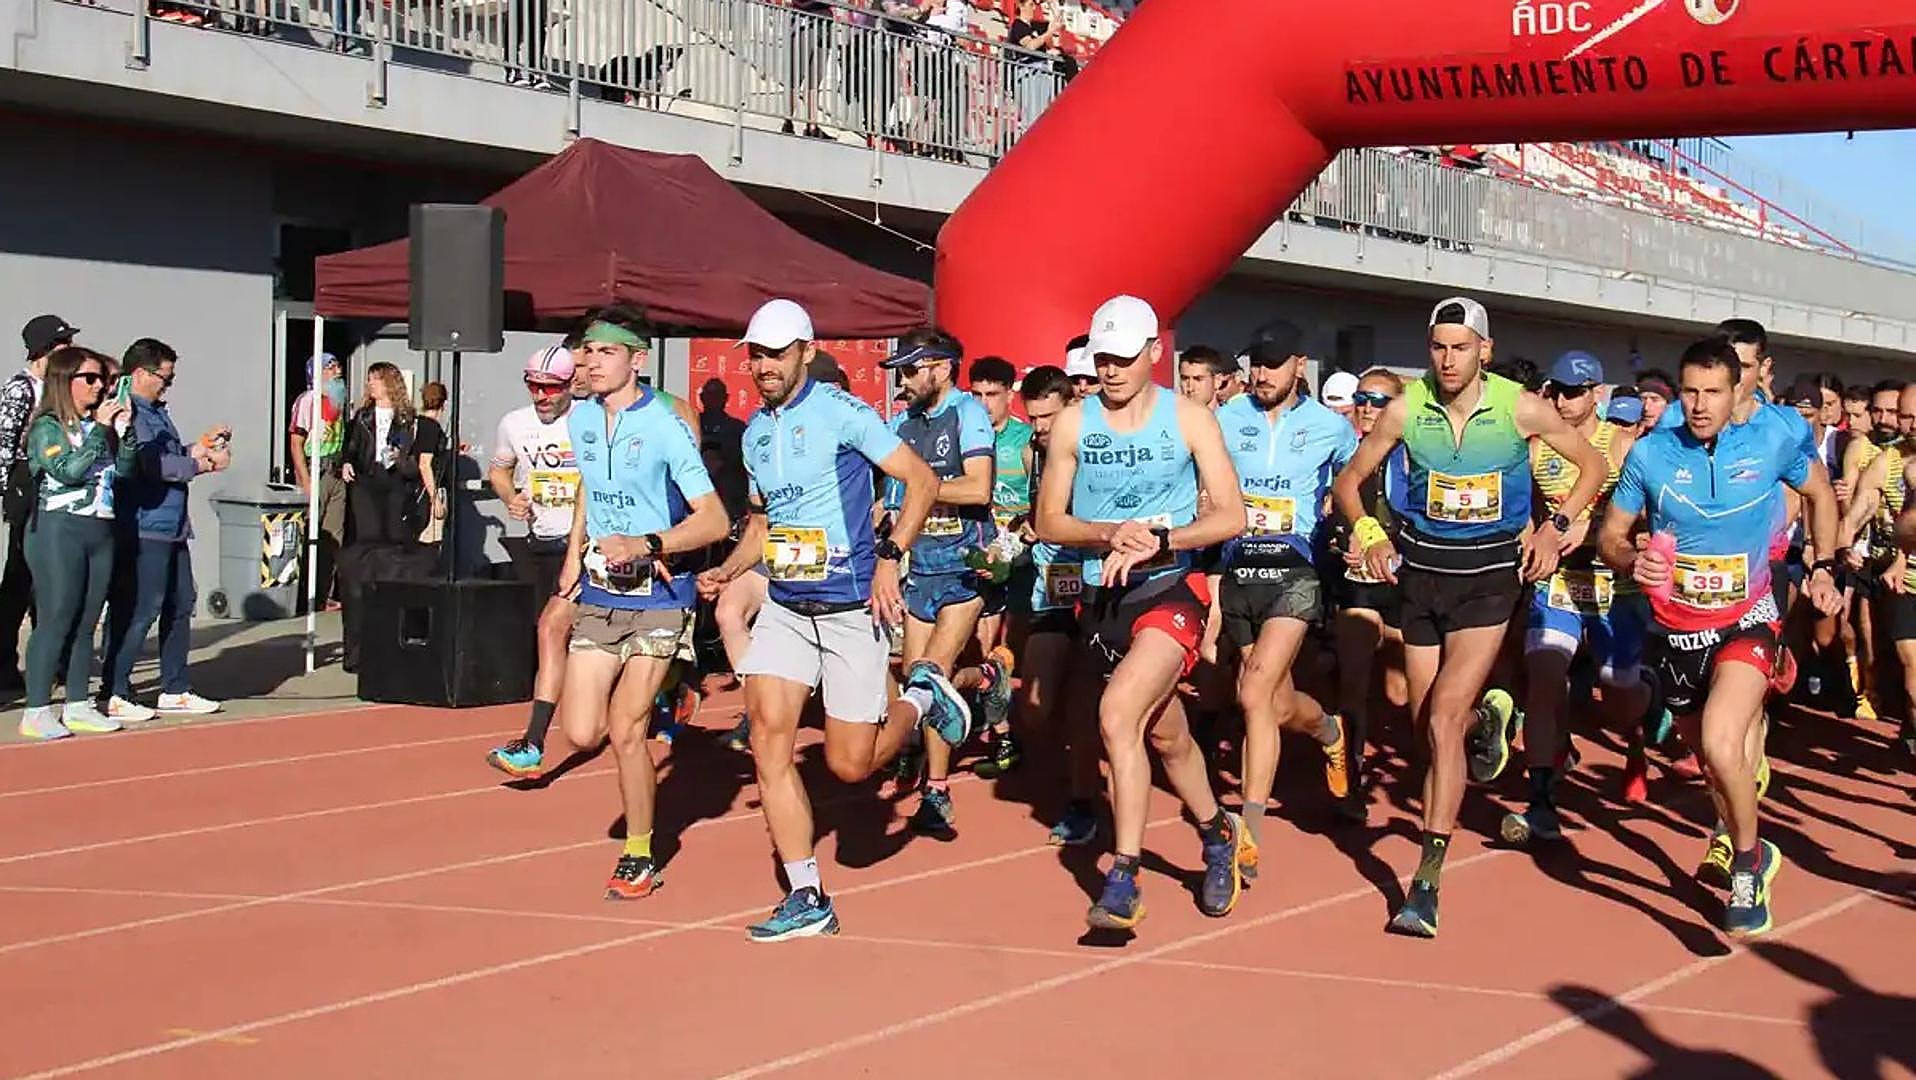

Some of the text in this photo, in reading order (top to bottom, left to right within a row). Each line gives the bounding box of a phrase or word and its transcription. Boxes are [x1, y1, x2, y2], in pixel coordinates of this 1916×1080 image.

[1345, 36, 1916, 104] AYUNTAMIENTO DE CÁRTA
[1083, 444, 1154, 468] nerja
[1243, 474, 1292, 491] nerja
[548, 484, 567, 497] 31
[767, 482, 804, 501] nerja
[592, 489, 636, 510] nerja
[1459, 494, 1472, 506] 5
[1255, 513, 1267, 527] 2
[790, 547, 801, 562] 7
[1058, 579, 1080, 593] 20
[1693, 575, 1724, 590] 39
